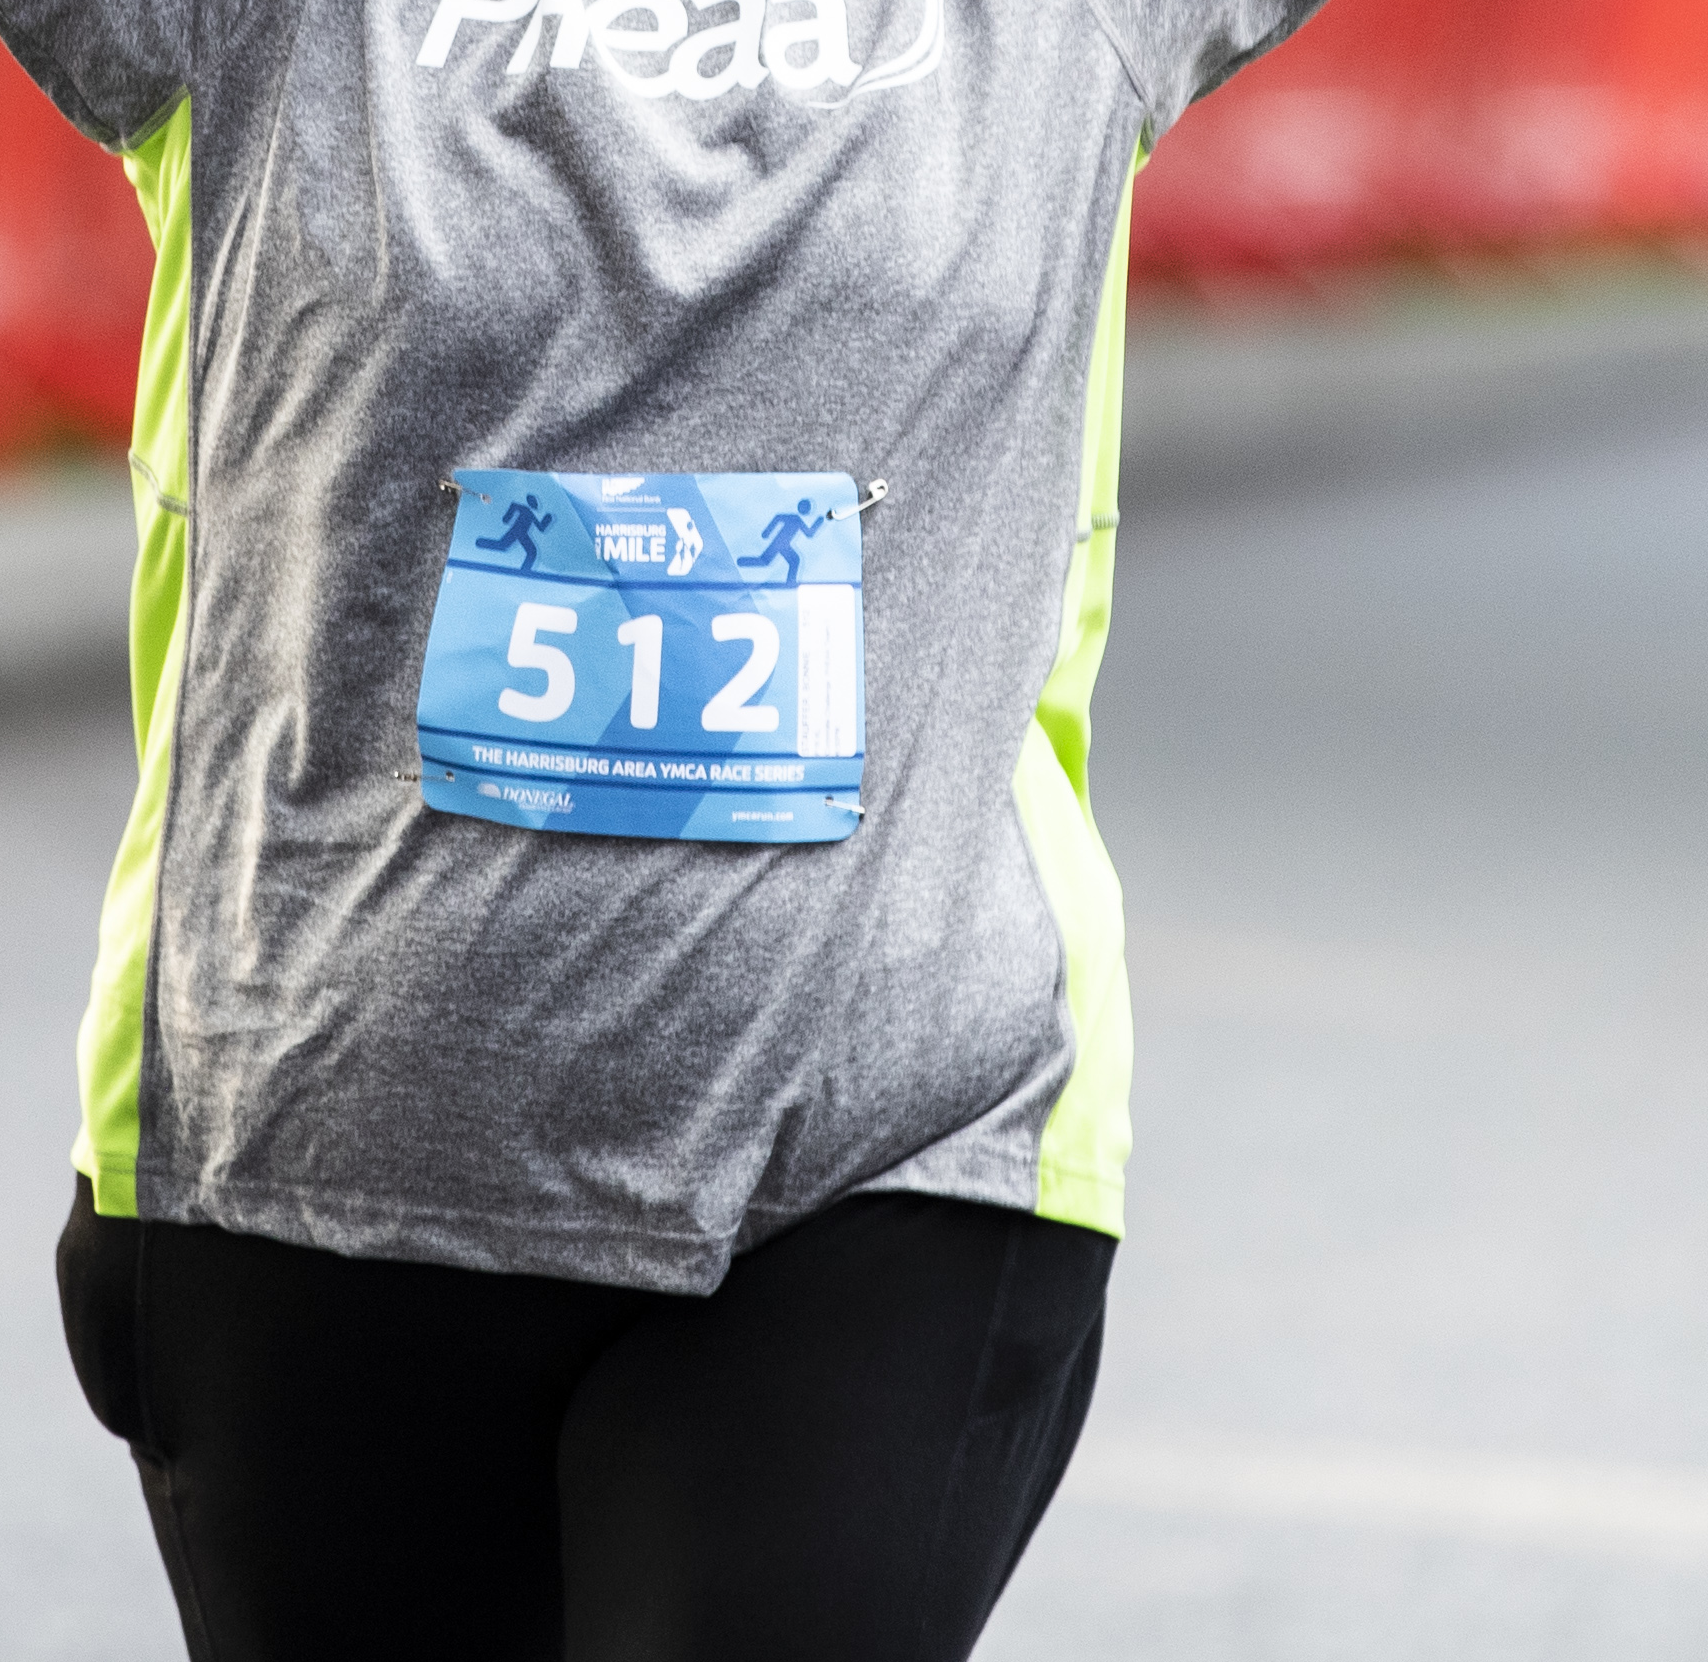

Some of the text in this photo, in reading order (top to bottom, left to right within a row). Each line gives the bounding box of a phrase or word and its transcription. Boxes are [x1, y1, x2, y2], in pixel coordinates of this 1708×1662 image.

[595, 524, 666, 537] HARRISBURG
[603, 536, 666, 562] MILE
[498, 602, 781, 732] 512
[472, 745, 805, 782] THE HARRISBURG AREA YMCA RACE SERIES
[502, 786, 574, 807] DONEGAL
